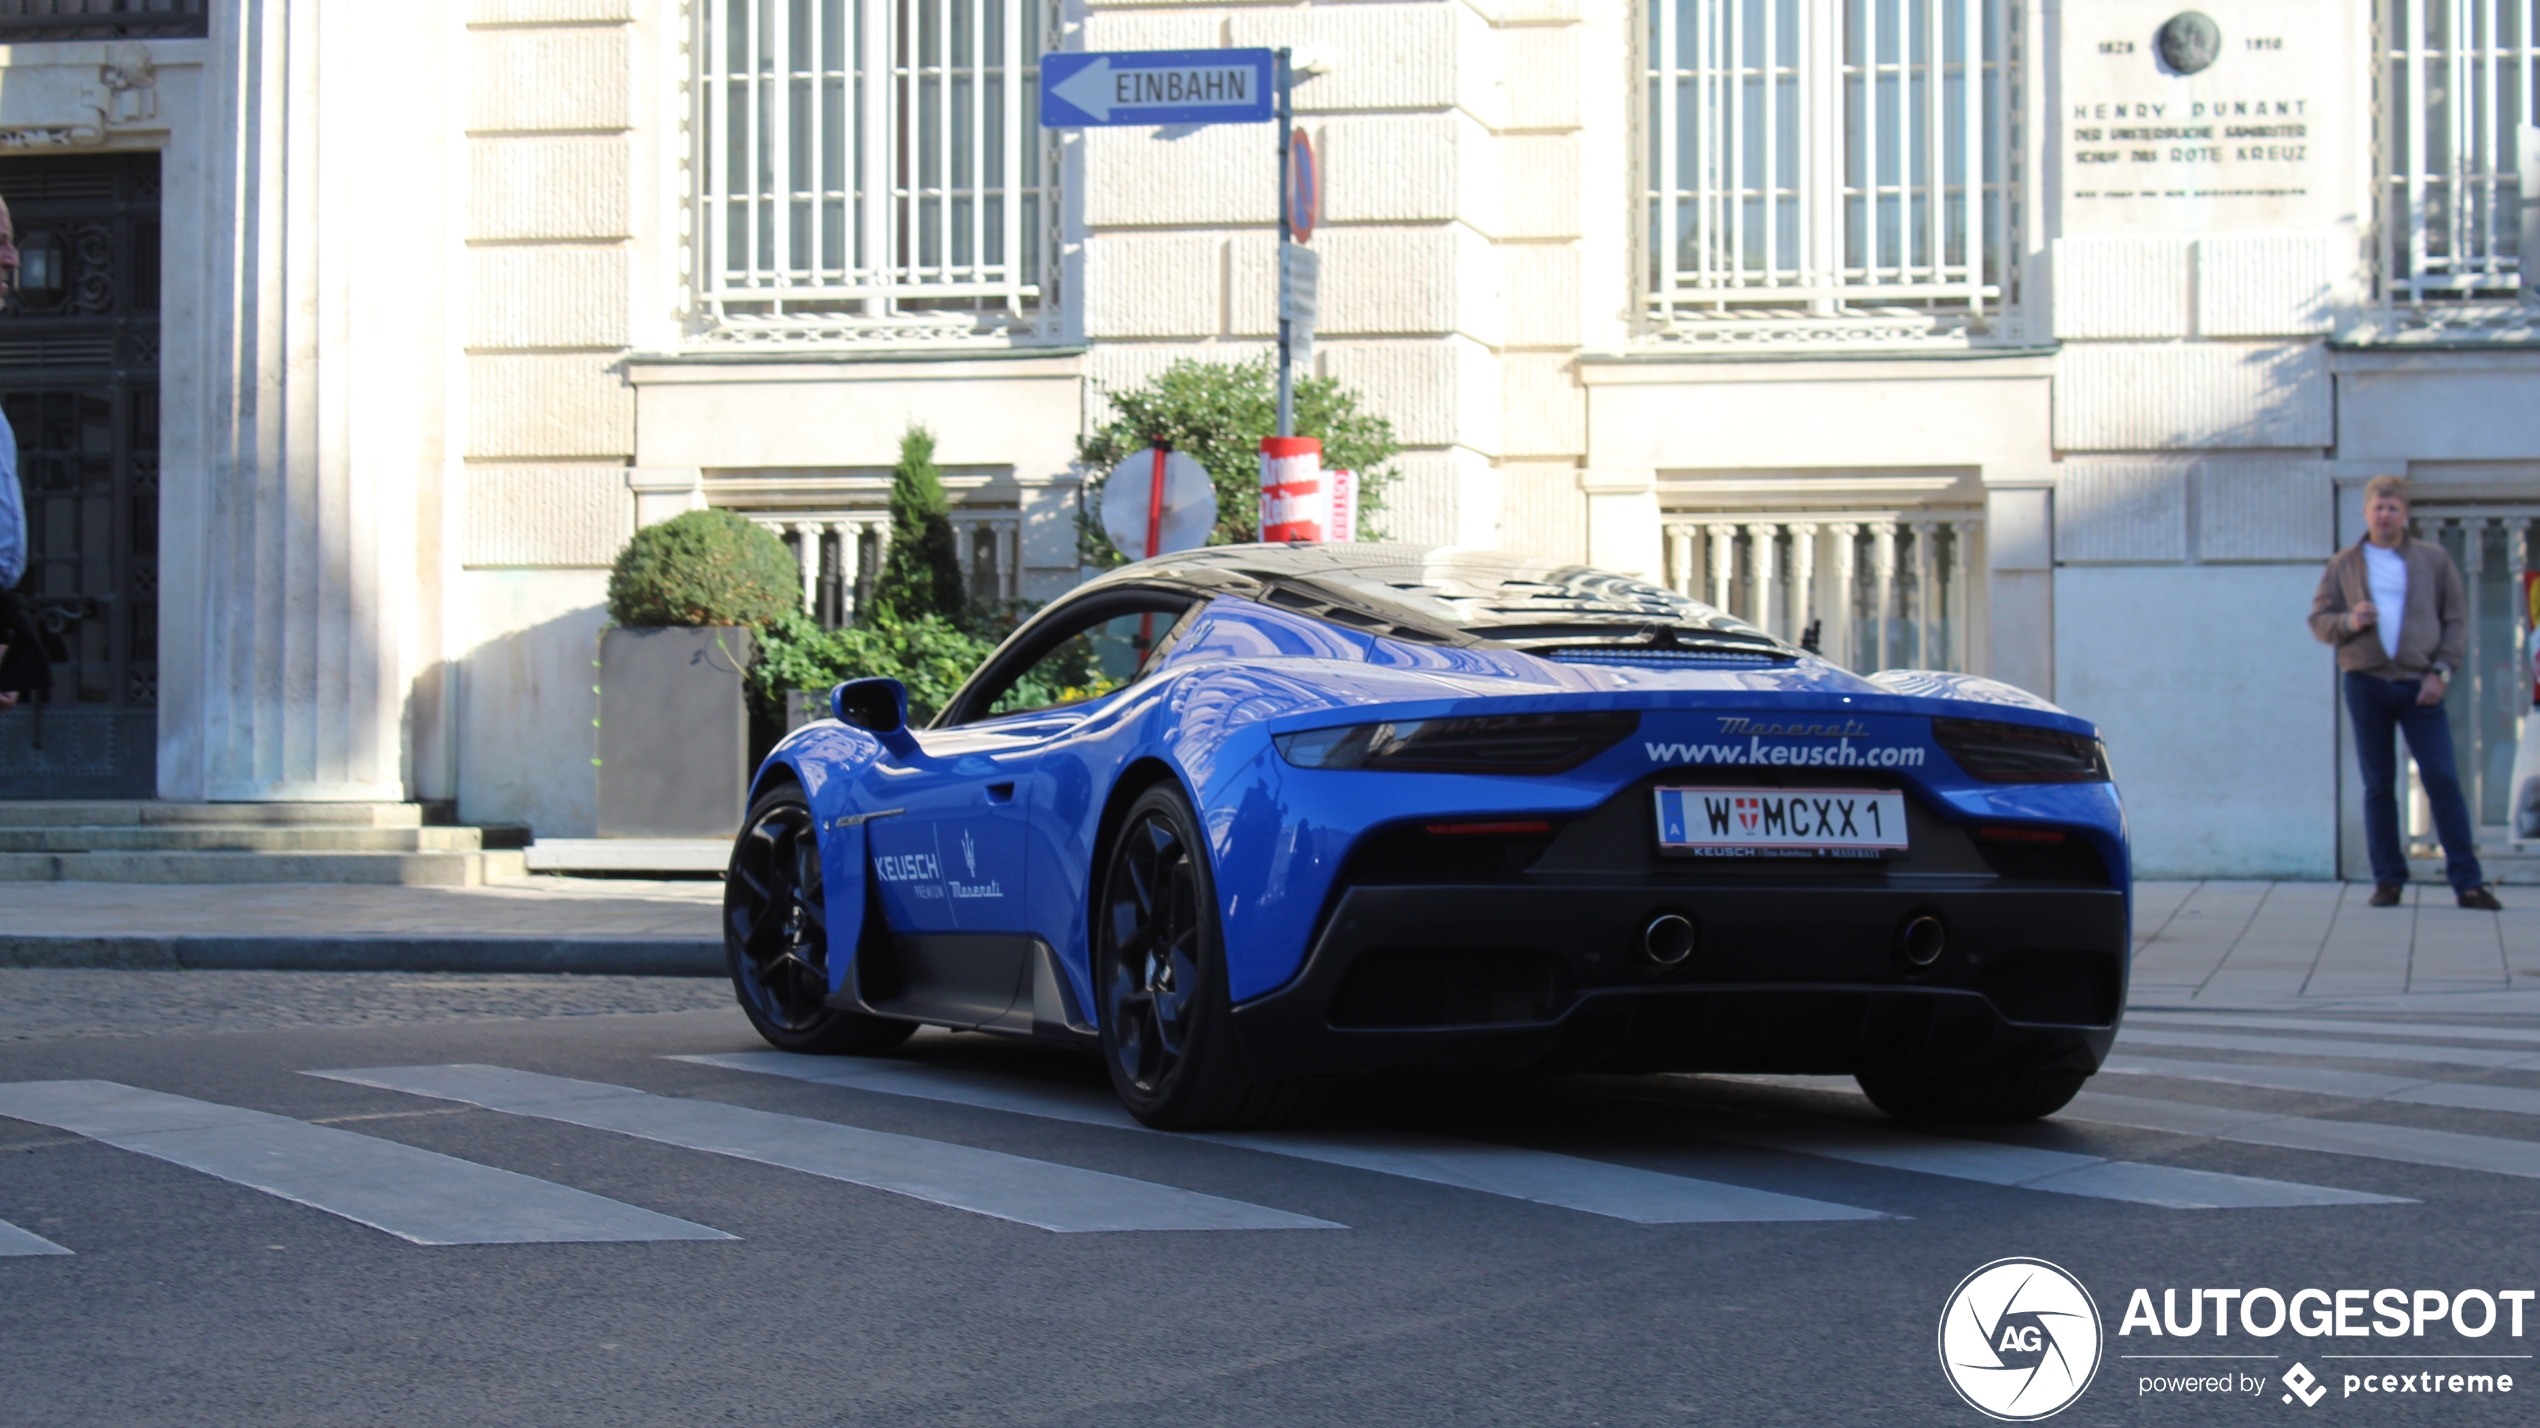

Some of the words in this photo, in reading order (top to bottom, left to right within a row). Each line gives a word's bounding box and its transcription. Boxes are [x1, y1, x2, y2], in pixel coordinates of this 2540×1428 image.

[2098, 41, 2135, 55] 1828
[2246, 38, 2283, 51] 1910
[1115, 70, 1245, 103] EINBAHN
[2074, 103, 2166, 119] HENRY
[2191, 99, 2306, 118] DUNANT
[2074, 128, 2102, 142] DER
[2130, 149, 2158, 163] DAS
[2170, 147, 2224, 164] ROTE
[2236, 145, 2307, 162] KREUZ
[1716, 716, 1870, 737] Maserati
[1645, 736, 1925, 766] www.keusch.com
[1669, 823, 1681, 836] A
[1704, 797, 1730, 836] W
[1694, 846, 1755, 857] KEUSCH
[1831, 848, 1880, 858] MASERATI
[874, 853, 940, 881] KEUSCH
[948, 879, 1003, 898] Maserati
